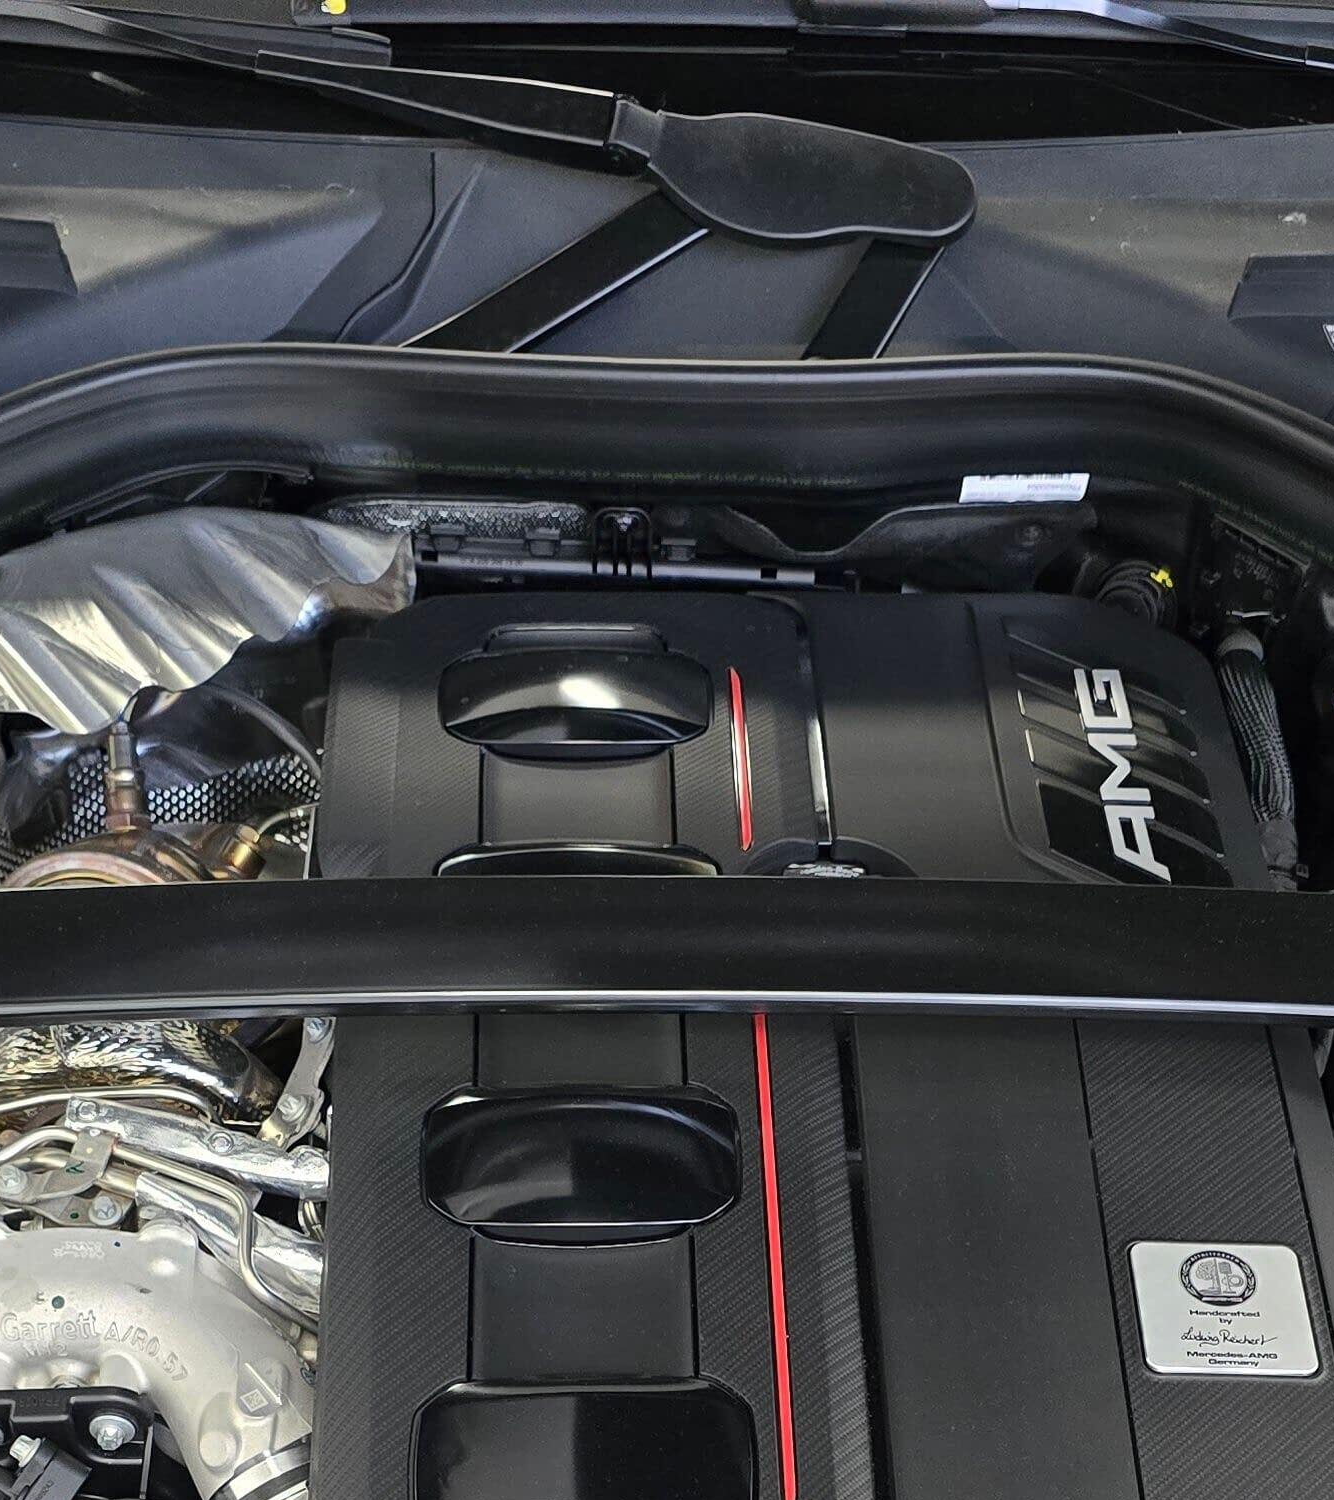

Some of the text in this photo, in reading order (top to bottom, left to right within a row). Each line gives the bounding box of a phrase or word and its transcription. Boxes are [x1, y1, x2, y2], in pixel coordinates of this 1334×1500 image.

[1073, 668, 1171, 883] AMG
[1189, 1309, 1260, 1318] Handcrafted
[0, 1310, 101, 1343] Garrett
[1186, 1351, 1278, 1360] Mercedes-AMG
[1208, 1359, 1259, 1367] Germany
